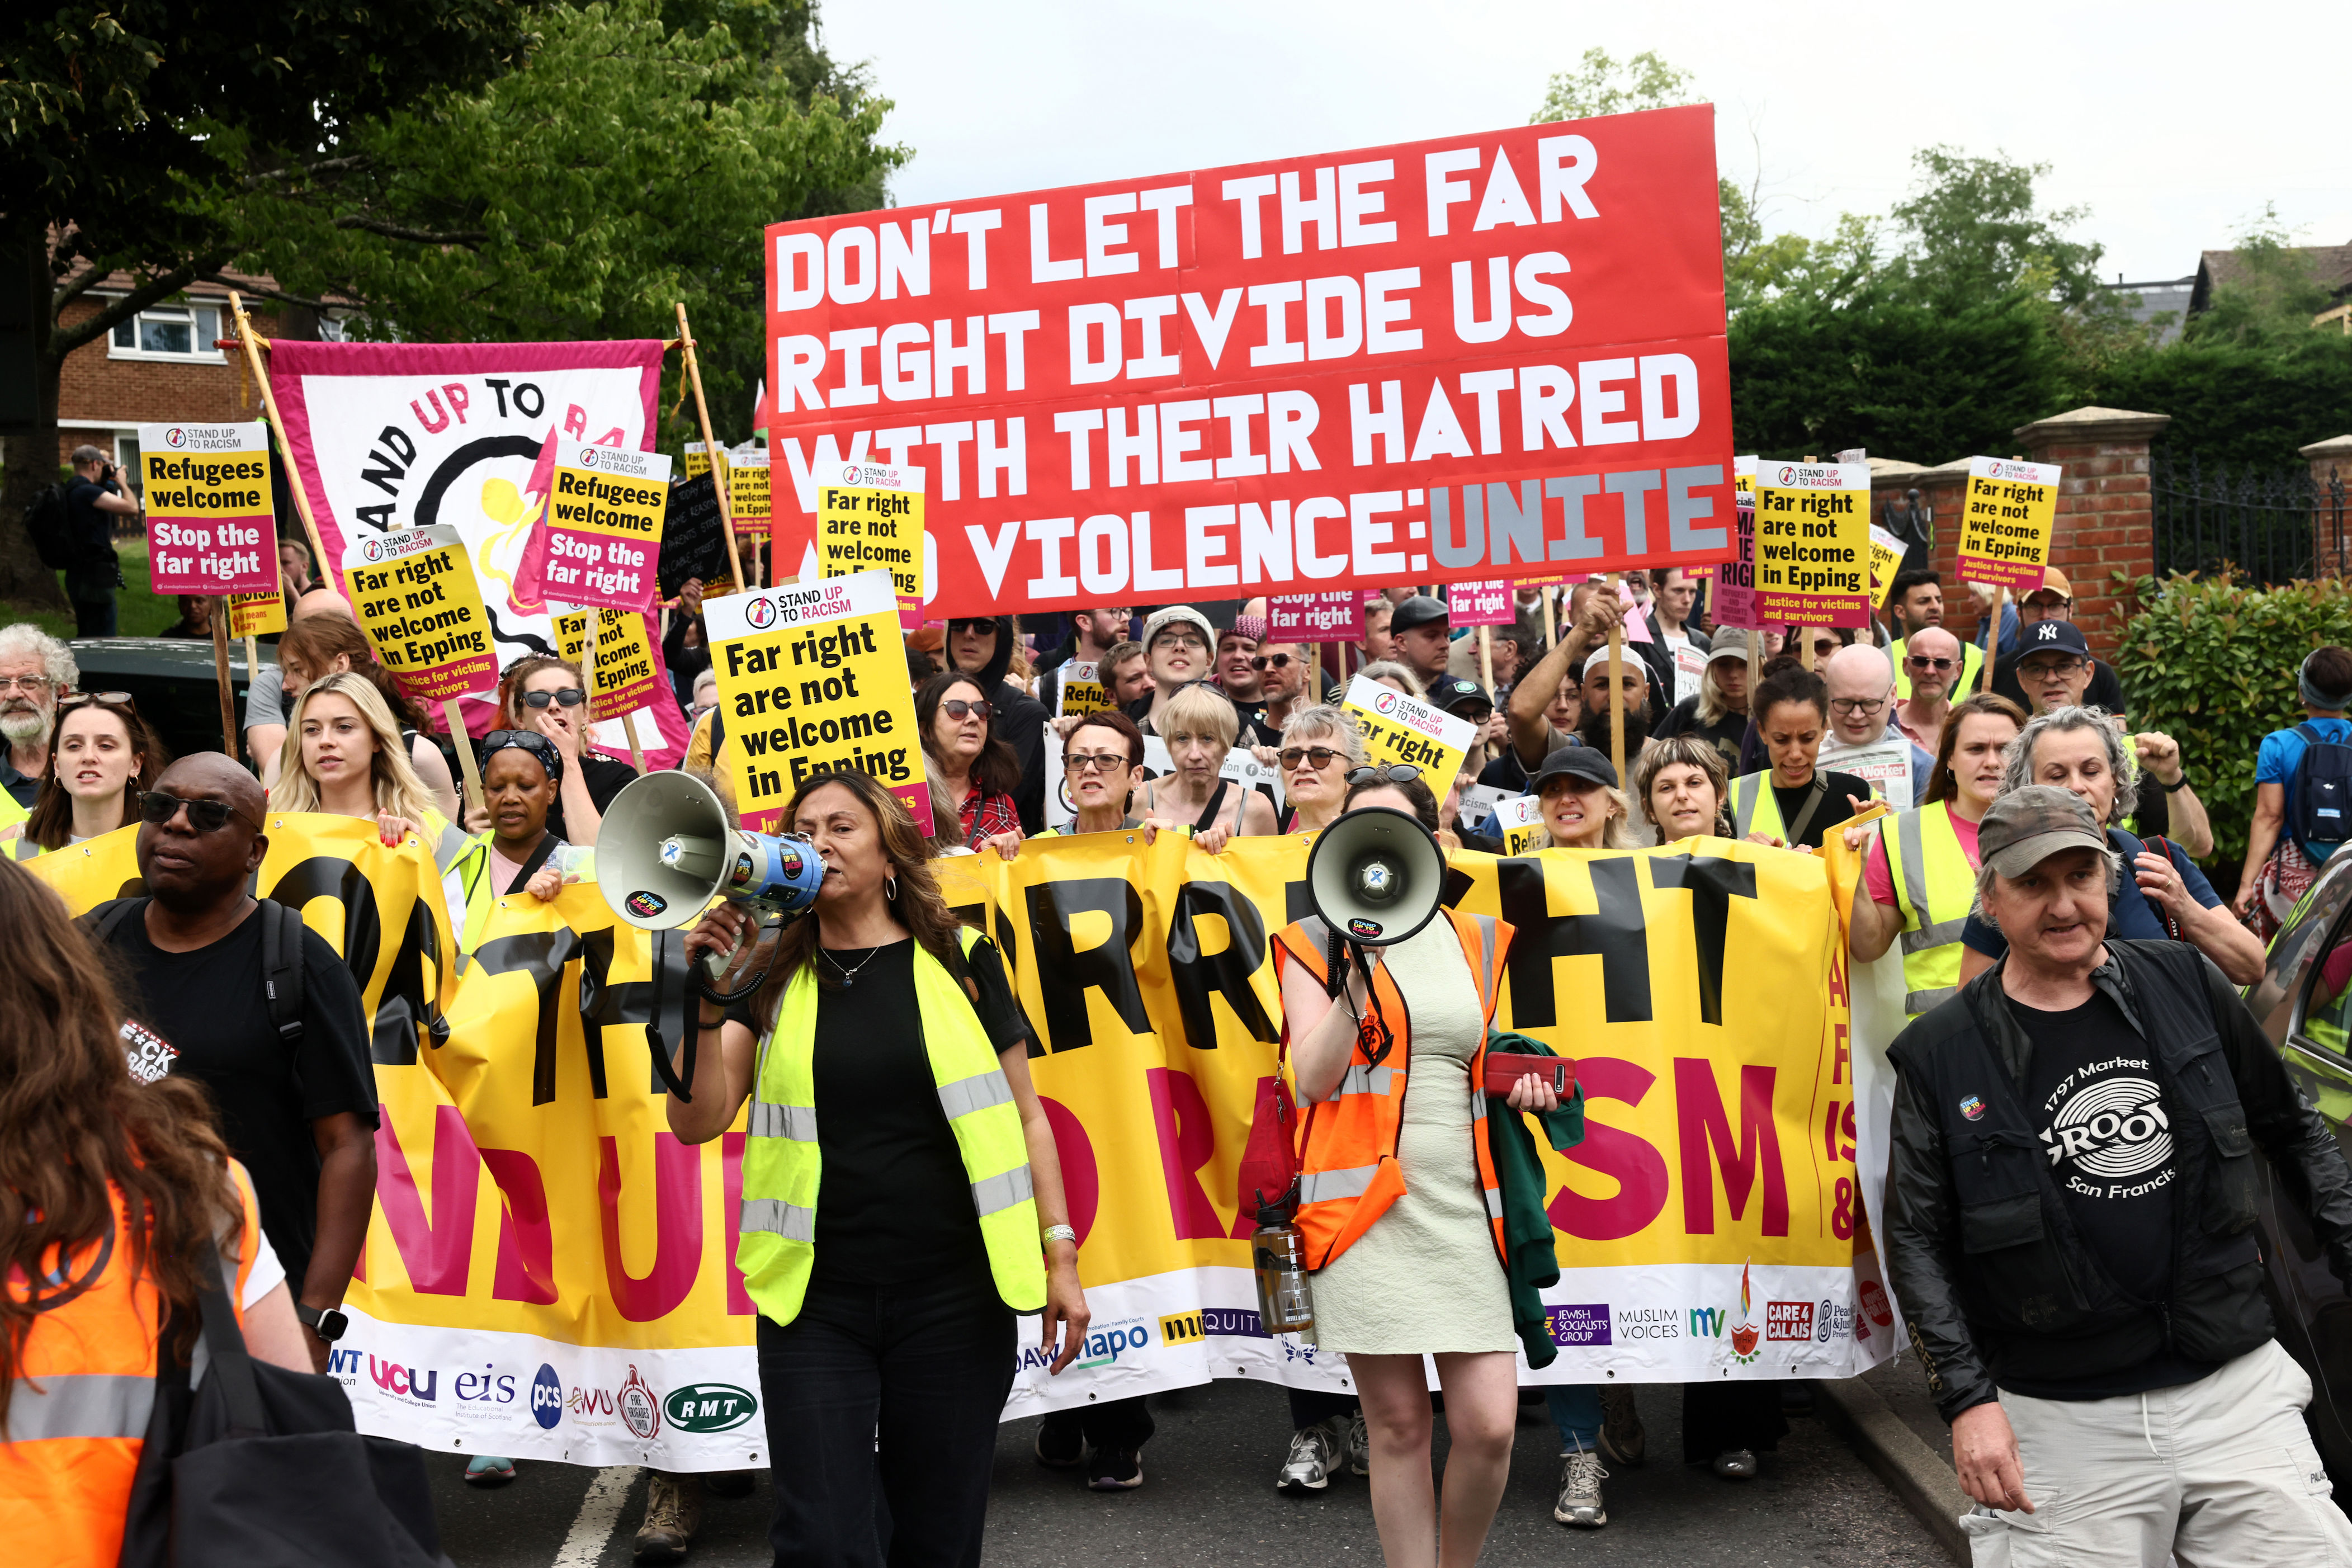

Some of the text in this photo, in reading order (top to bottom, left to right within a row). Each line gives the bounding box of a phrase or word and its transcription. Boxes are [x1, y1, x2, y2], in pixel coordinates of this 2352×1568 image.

[776, 134, 1600, 313] DON'T LET THE FAR
[777, 251, 1573, 413] RIGHT DIVIDE US
[409, 378, 545, 434] UP TO
[1054, 389, 1322, 491] THEIR
[1349, 352, 1700, 467] HATRED
[188, 428, 235, 438] STAND UP
[188, 438, 241, 449] TO RACISM
[601, 451, 629, 463] STAND
[149, 457, 265, 486] Refugees
[613, 464, 647, 475] RACISM
[865, 468, 886, 477] STAND
[1799, 469, 1824, 478] STAND
[2005, 465, 2026, 473] STAND
[559, 472, 662, 507] Refugees
[876, 478, 901, 487] RACISM
[1811, 478, 1842, 487] RACISM
[1974, 479, 2044, 504] Far right
[152, 485, 261, 508] welcome
[828, 490, 910, 517] Far right
[1764, 490, 1853, 518] Far right
[556, 502, 653, 532] welcome
[668, 511, 687, 530] SAME
[1429, 464, 1728, 568] UNITE
[1971, 502, 2029, 519] are not
[154, 523, 259, 552] Stop the
[827, 519, 897, 538] are not
[1763, 520, 1796, 536] are
[1802, 519, 1837, 537] not
[1970, 520, 2040, 540] welcome
[384, 530, 426, 548] STAND UP
[399, 537, 433, 554] RACISM
[668, 528, 697, 551] PARENTS
[694, 537, 718, 558] STREET
[1966, 535, 2042, 563] in Epping
[549, 533, 645, 567] Stop the
[827, 540, 911, 564] welcome
[1763, 541, 1855, 563] welcome
[157, 551, 261, 580] far right
[352, 551, 454, 593] Far right
[546, 560, 640, 594] far right
[1513, 578, 1527, 587] and
[1764, 564, 1860, 592] in Epping
[362, 582, 445, 618] are not
[778, 586, 843, 608] STAND UP
[1722, 588, 1748, 599] REFUGEES
[1764, 596, 1860, 610] Justice for victims
[781, 599, 852, 622] TO RACISM
[1451, 593, 1505, 615] far right
[371, 606, 471, 642] welcome
[1271, 606, 1352, 630] far right
[1722, 615, 1746, 624] WELCOME
[1764, 610, 1834, 622] and survivors
[599, 623, 625, 645] not
[2038, 624, 2057, 640] NY
[380, 630, 486, 665] in Epping
[725, 622, 876, 677] Far right
[451, 660, 491, 677] victims
[596, 660, 650, 689] Epping
[626, 682, 654, 697] victims
[734, 667, 859, 717] are not
[1400, 700, 1443, 725] STAND UP
[740, 709, 894, 757] welcome
[1396, 710, 1443, 736] TO RACISM
[1386, 731, 1444, 770] right
[1862, 764, 1905, 778] Worker
[747, 765, 782, 798] in
[630, 899, 656, 915] RACISM
[641, 893, 663, 908] STAND
[1353, 927, 1379, 935] RACISM
[1354, 919, 1376, 928] STAND
[2044, 1056, 2150, 1112] 1797 Market
[1960, 1097, 1978, 1109] STAND
[2066, 1175, 2102, 1197] San
[1286, 1314, 1298, 1322] REFILL
[1558, 1310, 1591, 1320] JEWISH
[1619, 1309, 1678, 1323] MUSLIM
[1768, 1305, 1810, 1321] CARE 4
[1087, 1323, 1110, 1332] Probation
[1112, 1319, 1128, 1327] Family
[1619, 1325, 1678, 1339] VOICES
[1768, 1322, 1811, 1339] CALAIS
[1560, 1331, 1593, 1342] GROUP
[455, 1363, 515, 1403] eis
[379, 1388, 396, 1400] University
[404, 1398, 421, 1407] College
[533, 1383, 561, 1411] pcs
[572, 1386, 614, 1416] CWU
[630, 1395, 642, 1406] FIRE
[468, 1404, 503, 1413] Educational
[627, 1406, 649, 1419] BRIGADES
[681, 1399, 738, 1418] RMT
[636, 1419, 649, 1431] UNION
